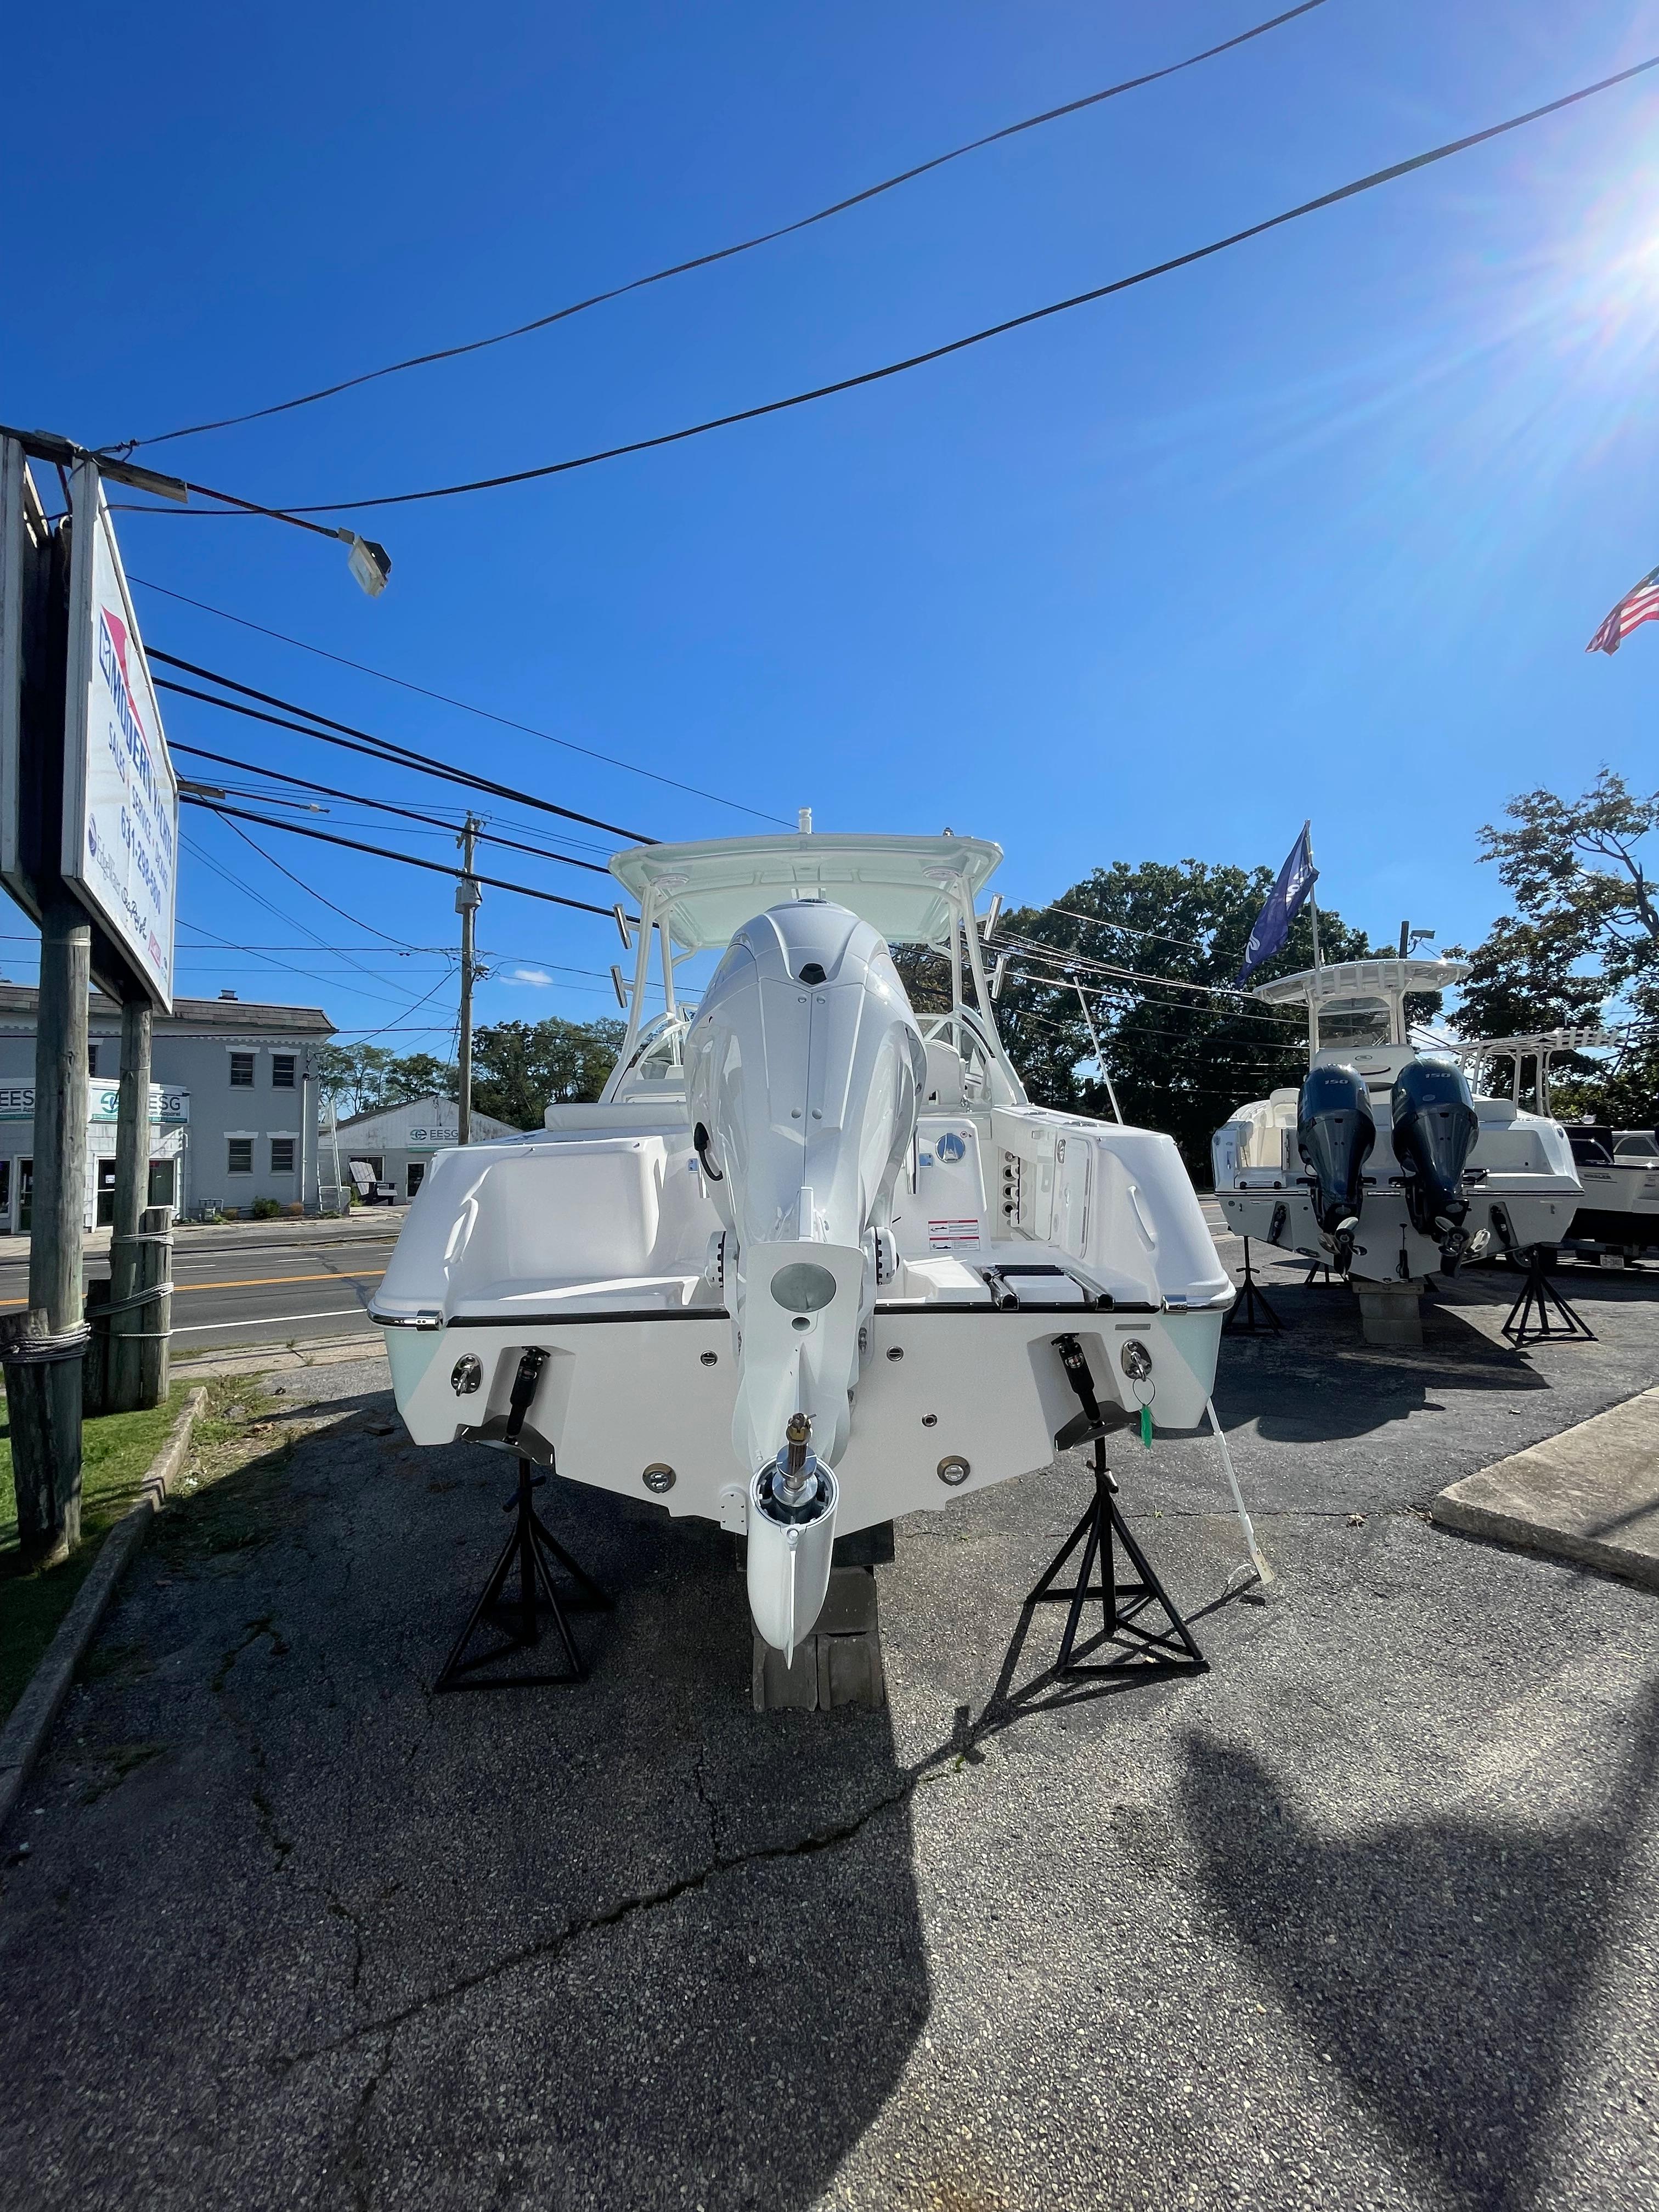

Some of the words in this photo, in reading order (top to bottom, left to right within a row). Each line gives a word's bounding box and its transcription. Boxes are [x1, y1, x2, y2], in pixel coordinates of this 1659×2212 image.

[110, 651, 153, 803] MODERN
[109, 721, 125, 783] SALES
[0, 1090, 34, 1106] EES
[148, 1095, 180, 1111] ESG
[430, 1129, 459, 1138] EESG
